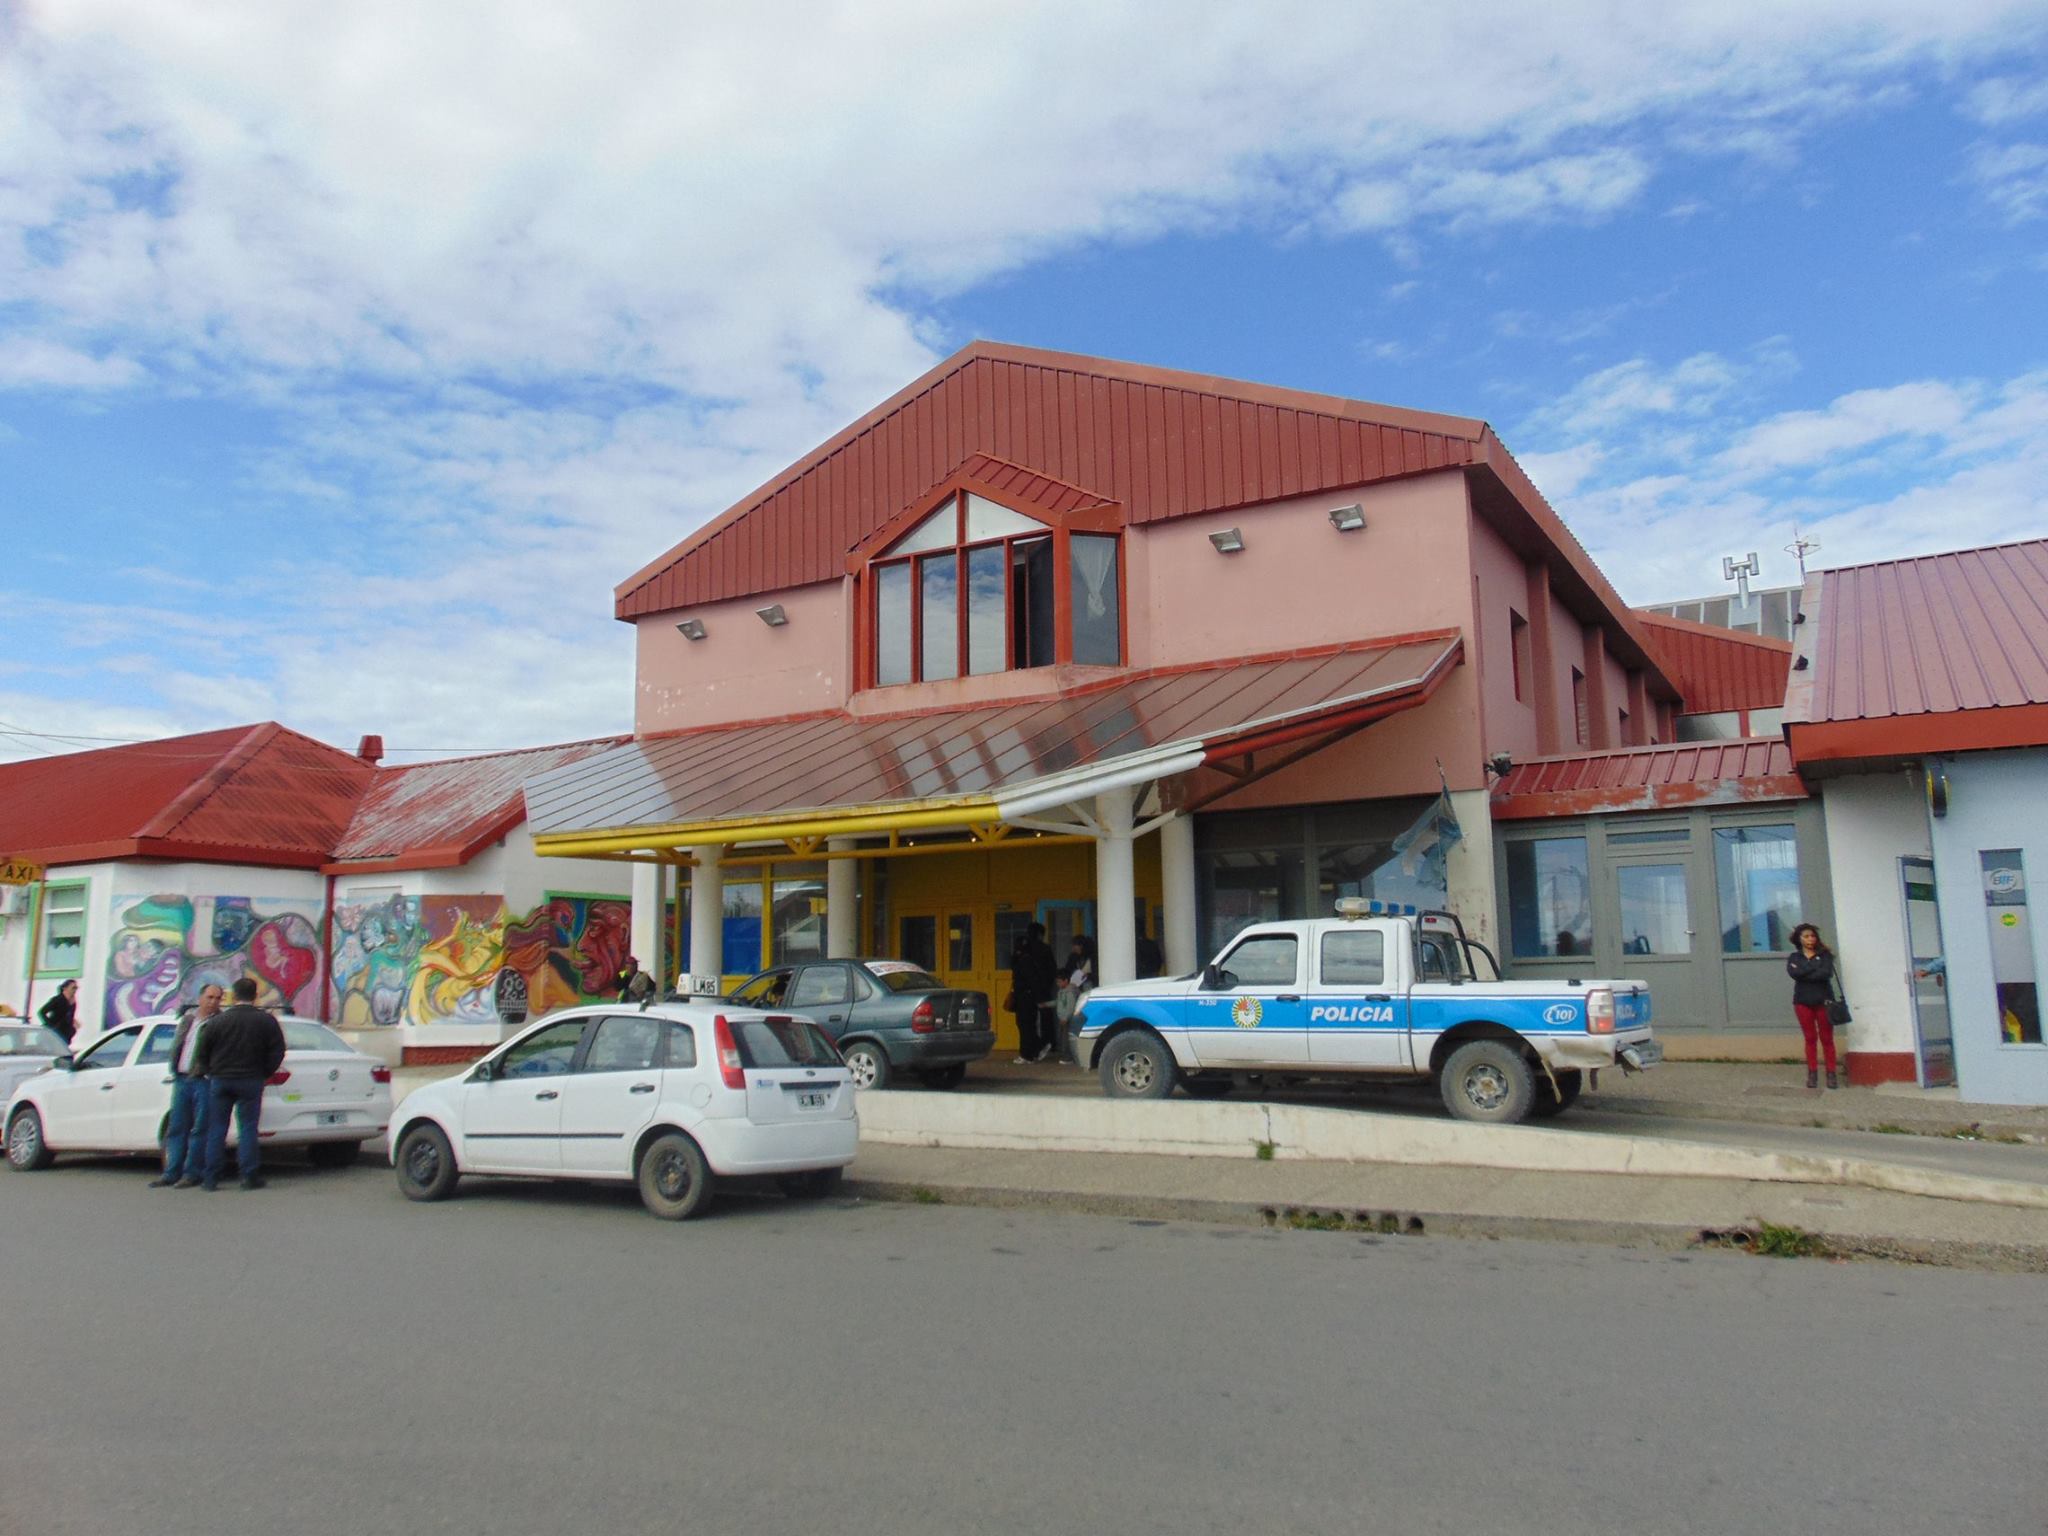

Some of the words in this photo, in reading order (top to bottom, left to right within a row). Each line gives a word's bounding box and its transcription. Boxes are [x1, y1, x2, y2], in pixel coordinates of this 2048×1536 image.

[2, 864, 33, 881] AXI
[1310, 1006, 1394, 1022] POLICIA
[1556, 1009, 1573, 1020] 101
